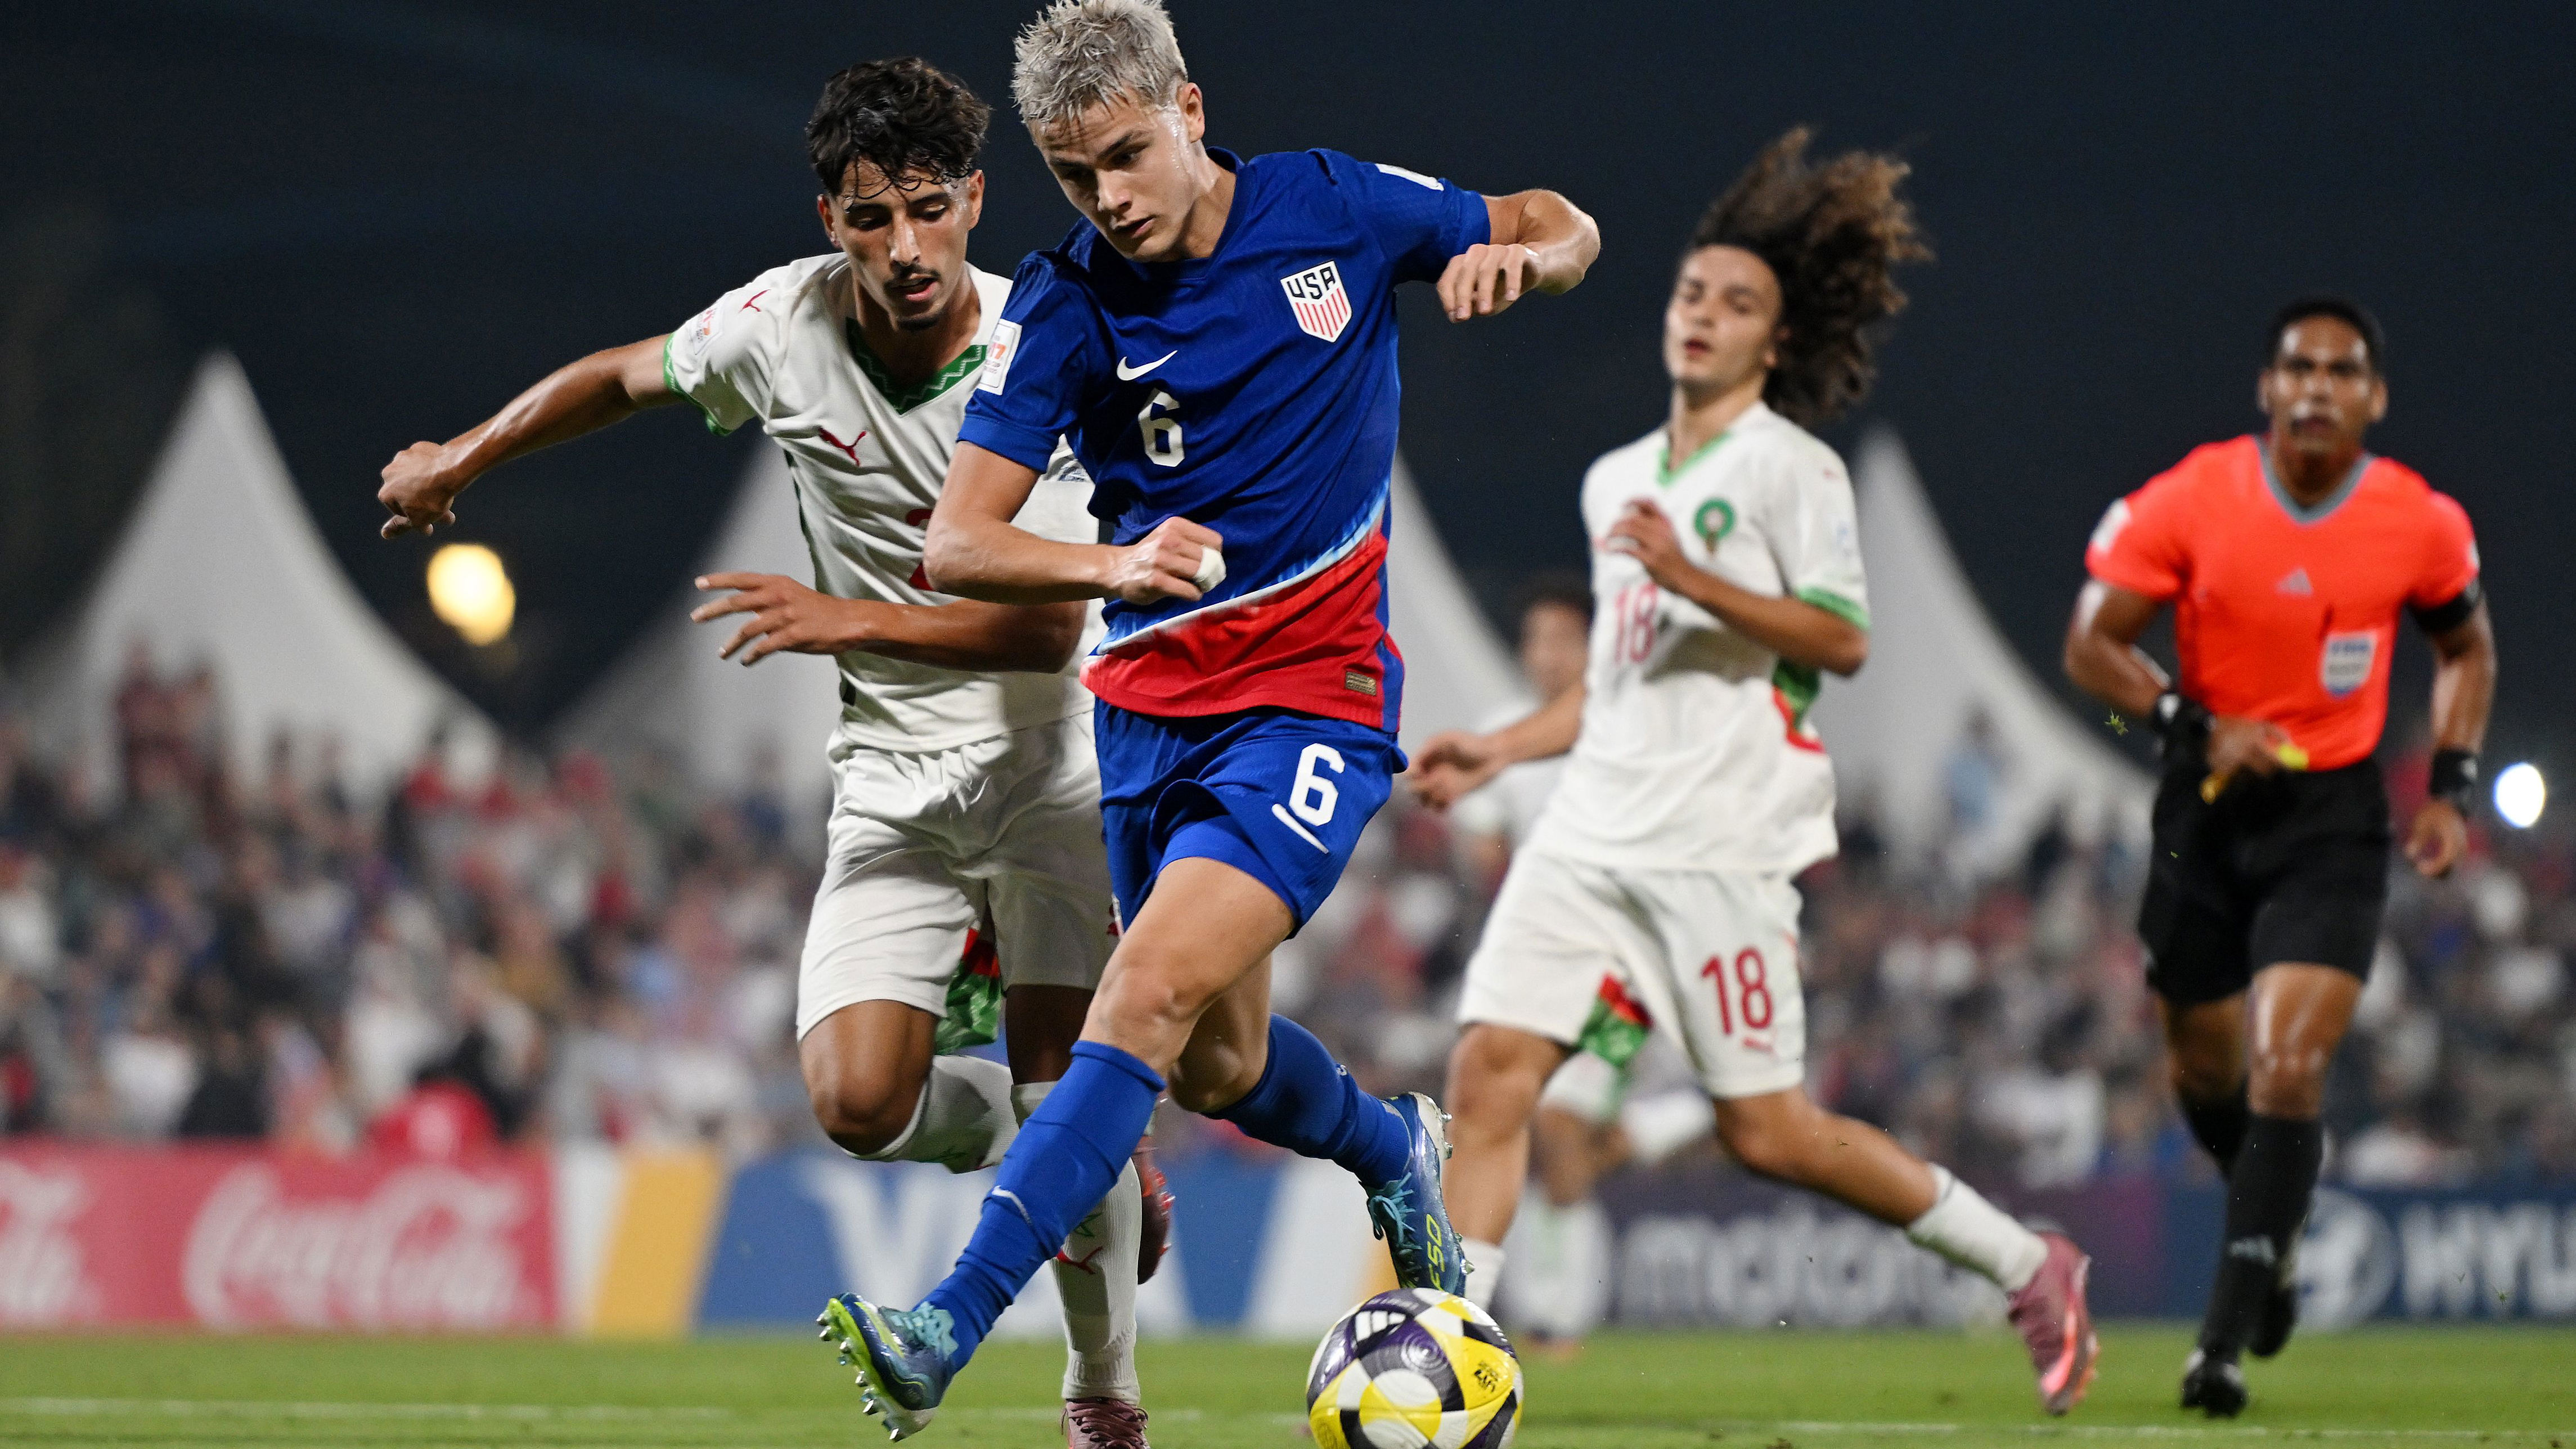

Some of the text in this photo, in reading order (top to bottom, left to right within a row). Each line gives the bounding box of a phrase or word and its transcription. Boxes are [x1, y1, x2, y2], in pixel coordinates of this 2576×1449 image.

[1287, 266, 1336, 299] USA
[1138, 388, 1184, 467] 6
[1614, 581, 1658, 665] 18
[1289, 743, 1345, 827] 6
[1700, 946, 1773, 1036] 18
